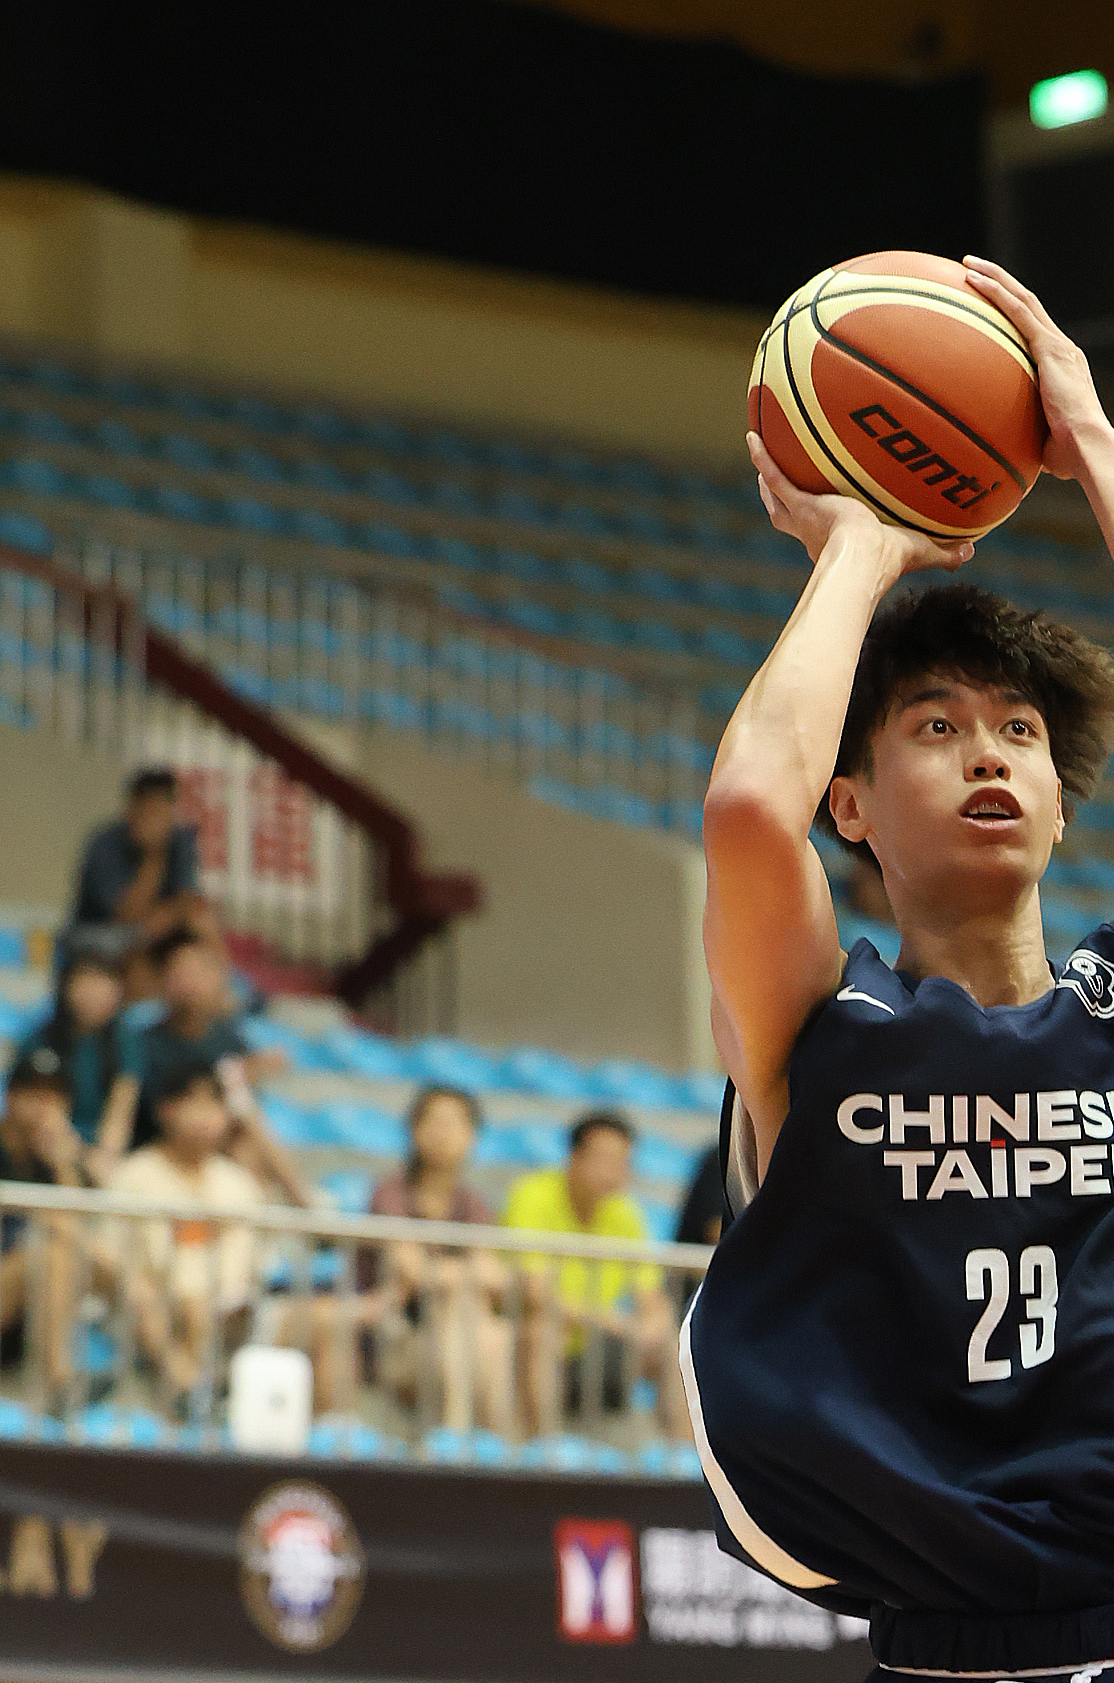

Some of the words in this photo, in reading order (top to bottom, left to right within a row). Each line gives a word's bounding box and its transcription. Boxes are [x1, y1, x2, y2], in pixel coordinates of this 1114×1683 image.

[849, 404, 1000, 509] conti
[965, 1245, 1058, 1383] 23
[0, 1514, 108, 1597] AY
